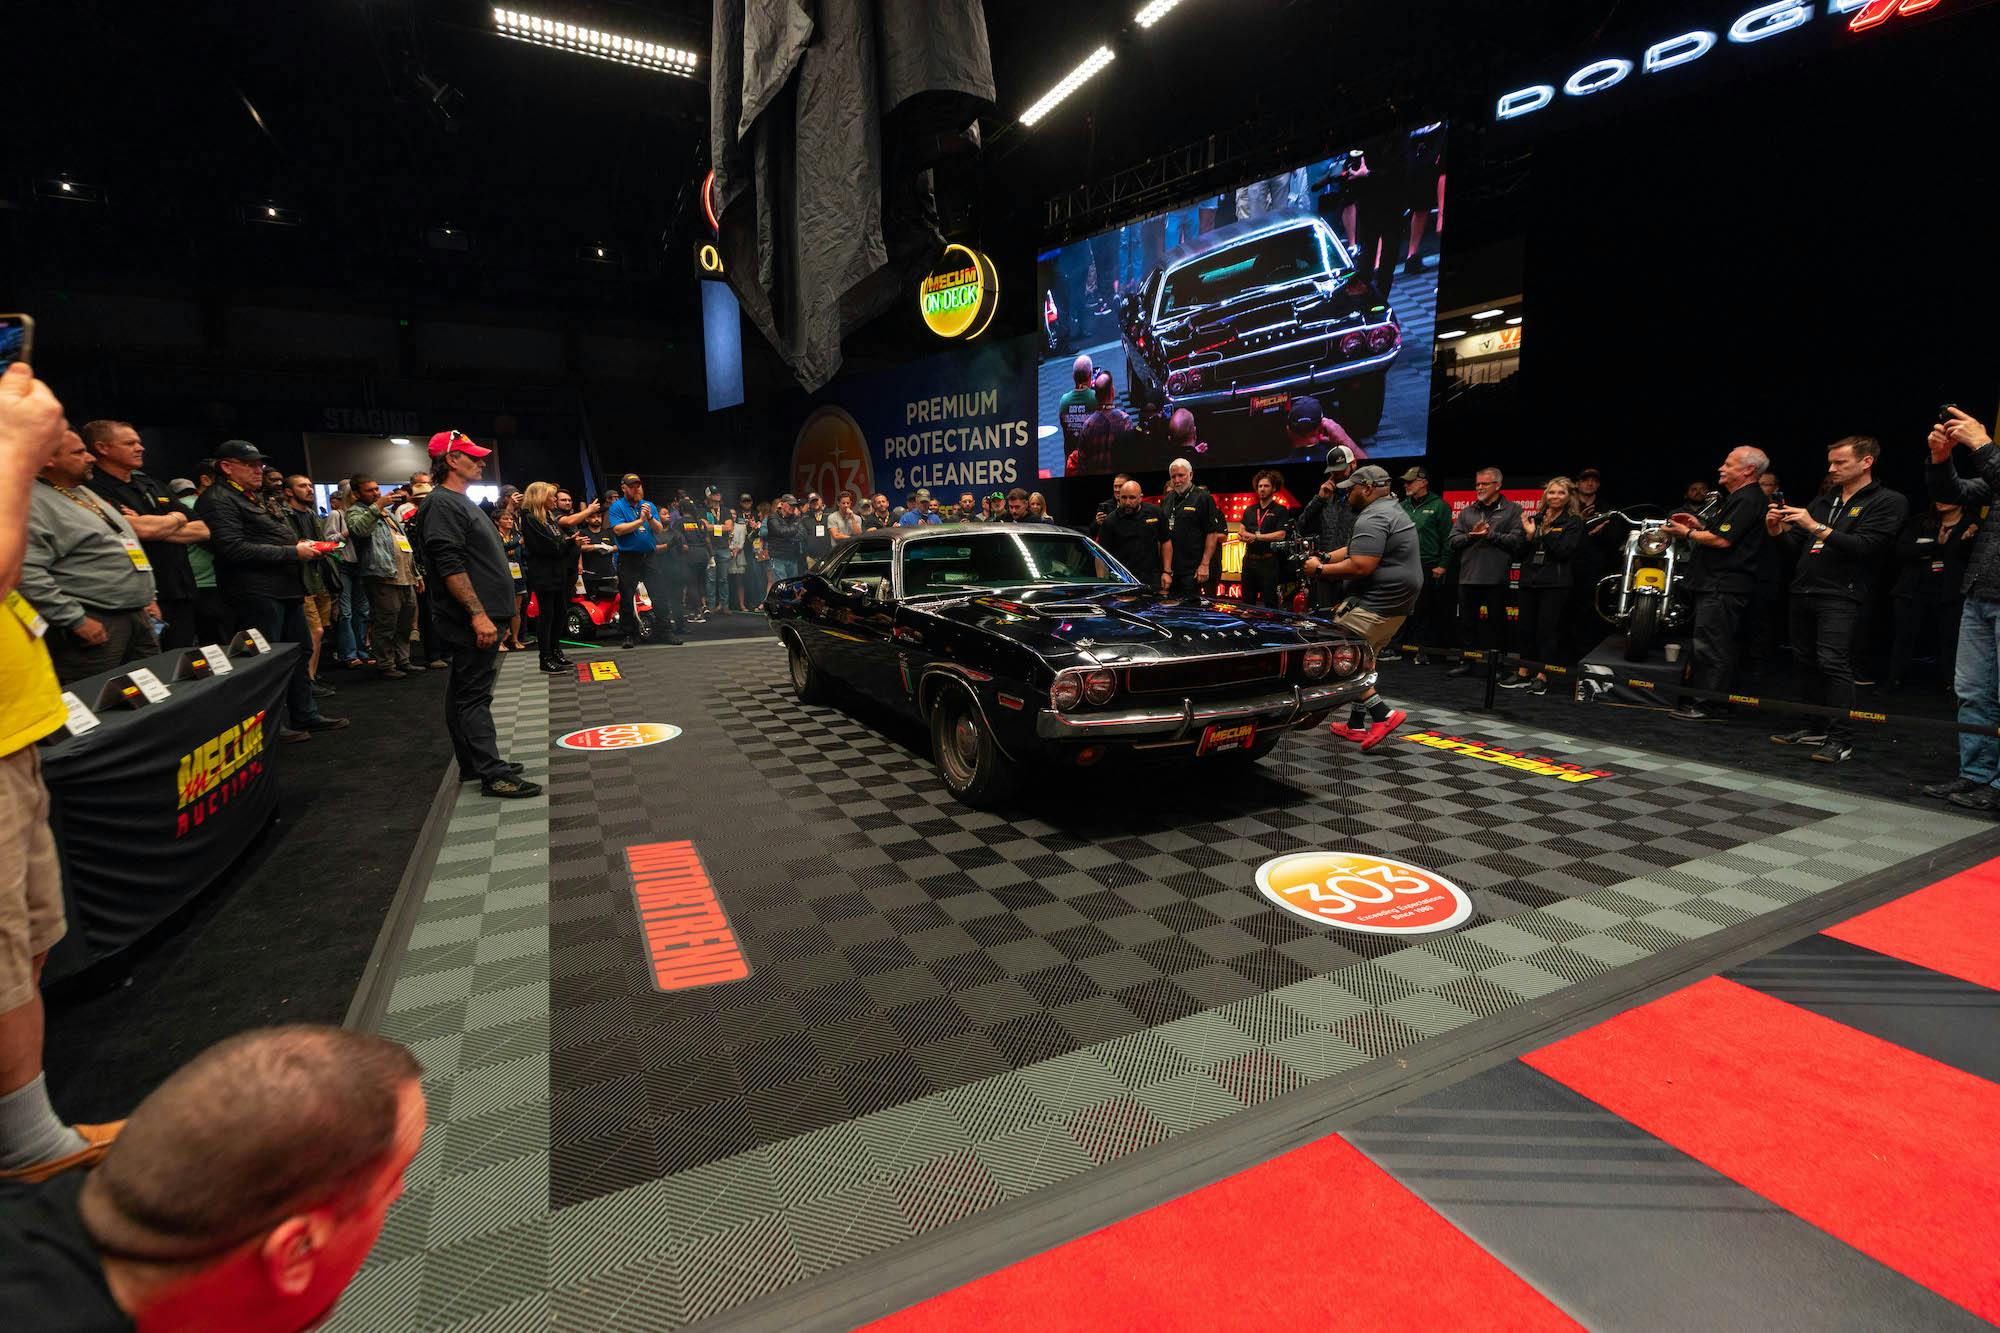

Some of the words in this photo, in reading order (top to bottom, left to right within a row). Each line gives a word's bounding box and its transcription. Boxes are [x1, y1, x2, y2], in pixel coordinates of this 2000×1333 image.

[1496, 0, 1888, 120] DODG
[926, 266, 977, 293] MECUM
[924, 293, 940, 313] ON
[944, 285, 977, 309] DECK
[322, 408, 419, 432] STAGING
[906, 389, 997, 425] PREMIUM
[884, 420, 1028, 459] PROTECTANTS
[801, 459, 862, 501] 303
[894, 468, 904, 489] &
[910, 458, 1017, 488] CLEANERS
[1850, 710, 1886, 720] MECUM
[597, 725, 644, 747] 303
[1210, 725, 1253, 743] MECUM
[177, 710, 265, 811] MECUM
[1398, 732, 1599, 783] MECUM
[1282, 865, 1431, 914] 303
[625, 839, 749, 991] MOTORTREND
